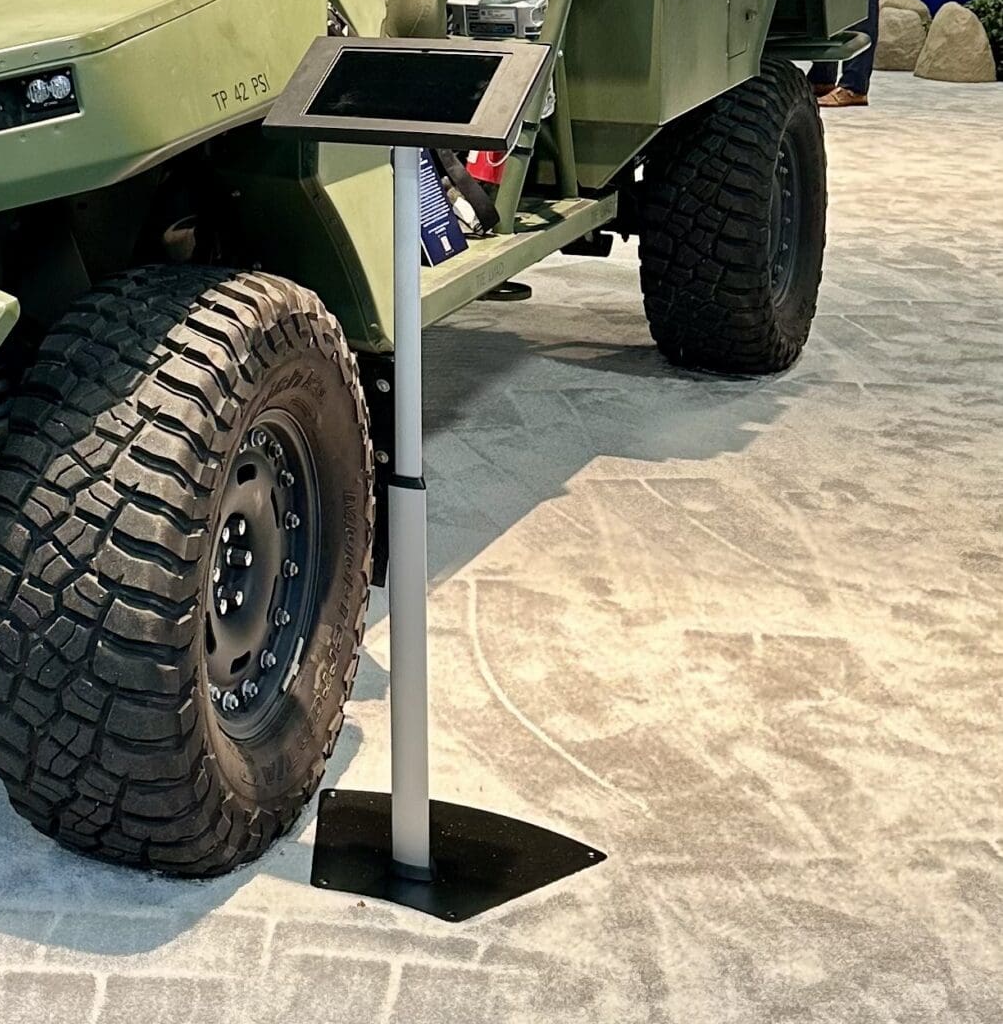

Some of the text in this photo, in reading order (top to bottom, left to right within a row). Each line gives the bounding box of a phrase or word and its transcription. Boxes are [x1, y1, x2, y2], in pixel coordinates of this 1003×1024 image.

[211, 73, 271, 111] TP 42 PSI
